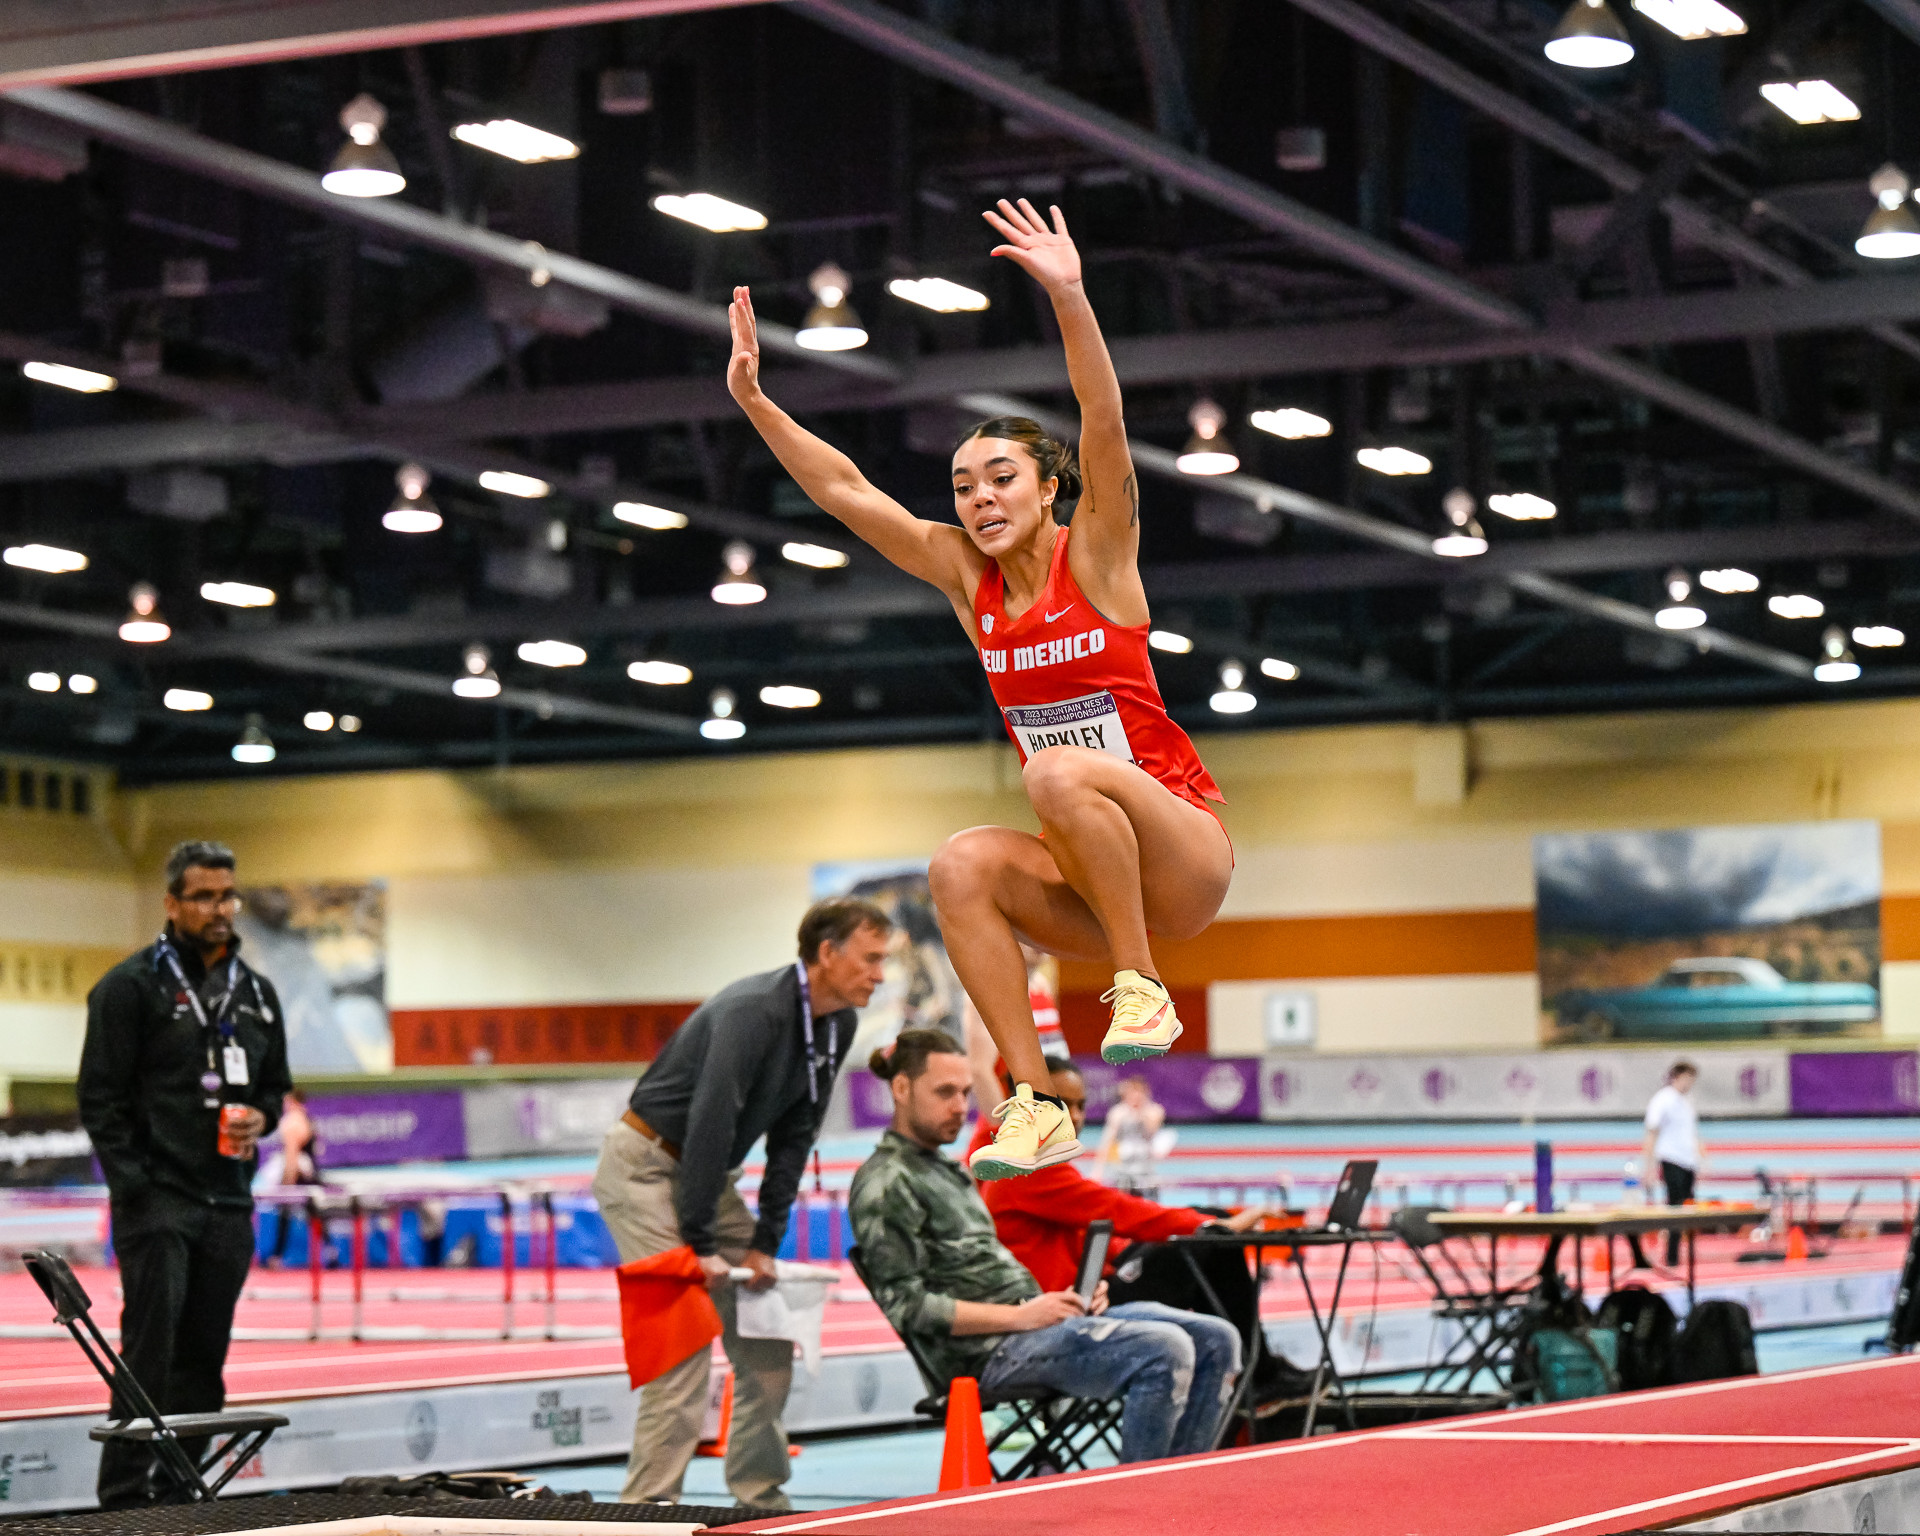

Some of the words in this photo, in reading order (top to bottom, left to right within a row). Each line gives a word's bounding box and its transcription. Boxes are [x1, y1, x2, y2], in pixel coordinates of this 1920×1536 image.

[1013, 628, 1106, 671] MEXICO
[1022, 717, 1048, 726] INDOOR
[1048, 703, 1114, 724] CHAMPIONSHIPS
[1023, 710, 1041, 718] 2023
[1040, 702, 1082, 717] MOUNTAIN
[1082, 697, 1105, 709] WEST
